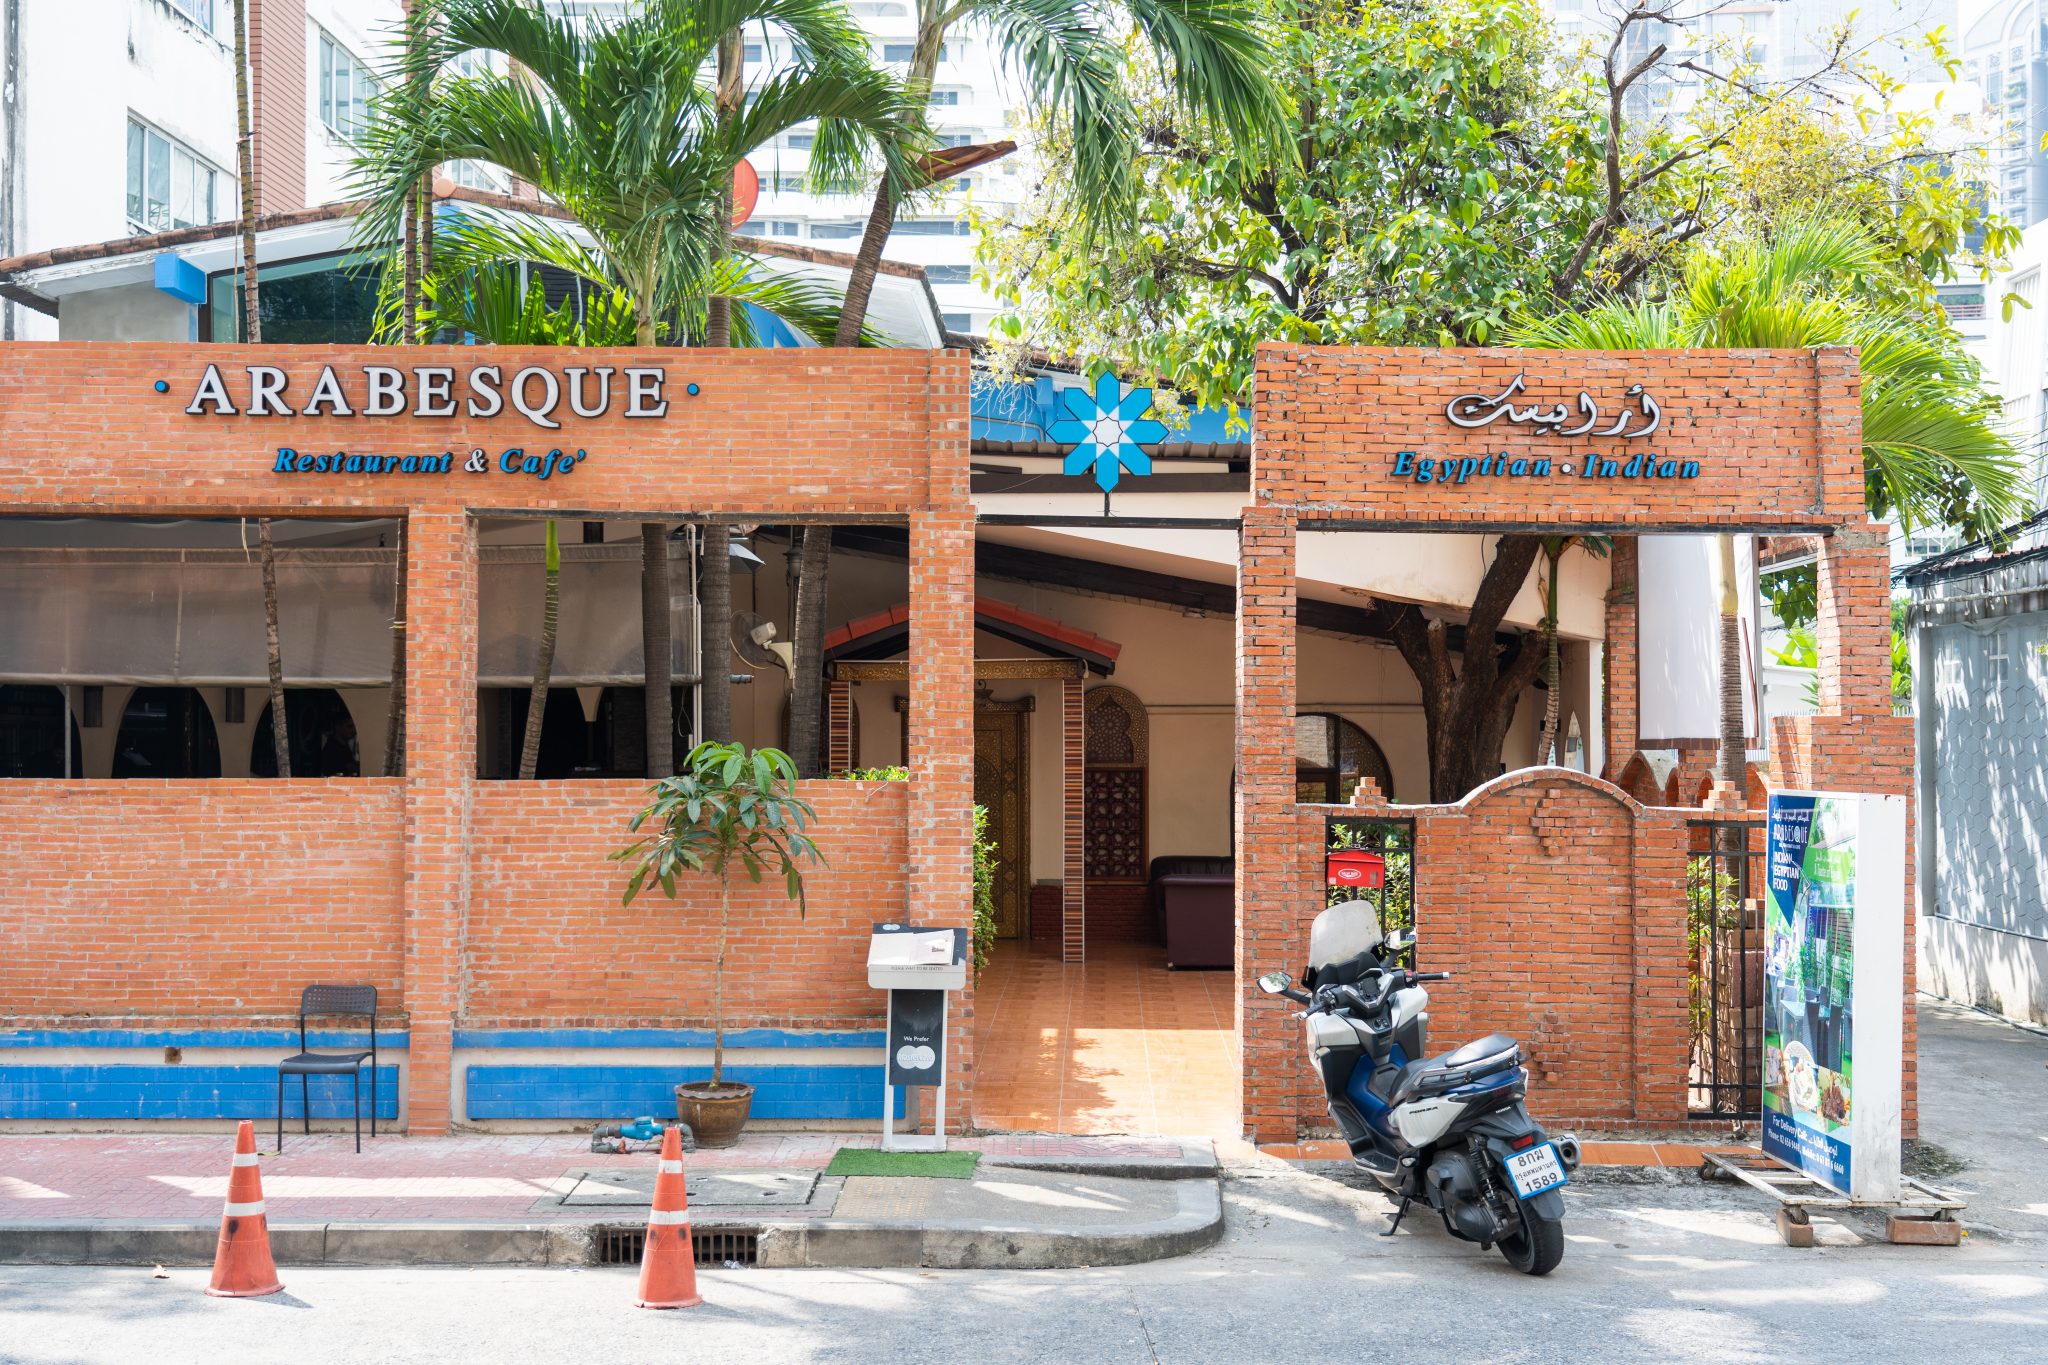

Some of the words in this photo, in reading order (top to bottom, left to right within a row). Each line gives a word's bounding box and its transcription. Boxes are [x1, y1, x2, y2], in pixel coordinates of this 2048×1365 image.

[184, 363, 669, 429] ARABESQUE
[272, 447, 454, 474] Restaurant
[463, 448, 488, 473] &
[1391, 451, 1551, 484] Egyptian
[1580, 453, 1700, 479] Indian
[1773, 851, 1793, 865] INDIAN
[1773, 864, 1800, 880] EGYPTIAN
[1773, 877, 1788, 891] FOOD
[1514, 1160, 1558, 1180] กรุงเทพมหานคร
[1525, 1172, 1558, 1192] 1589
